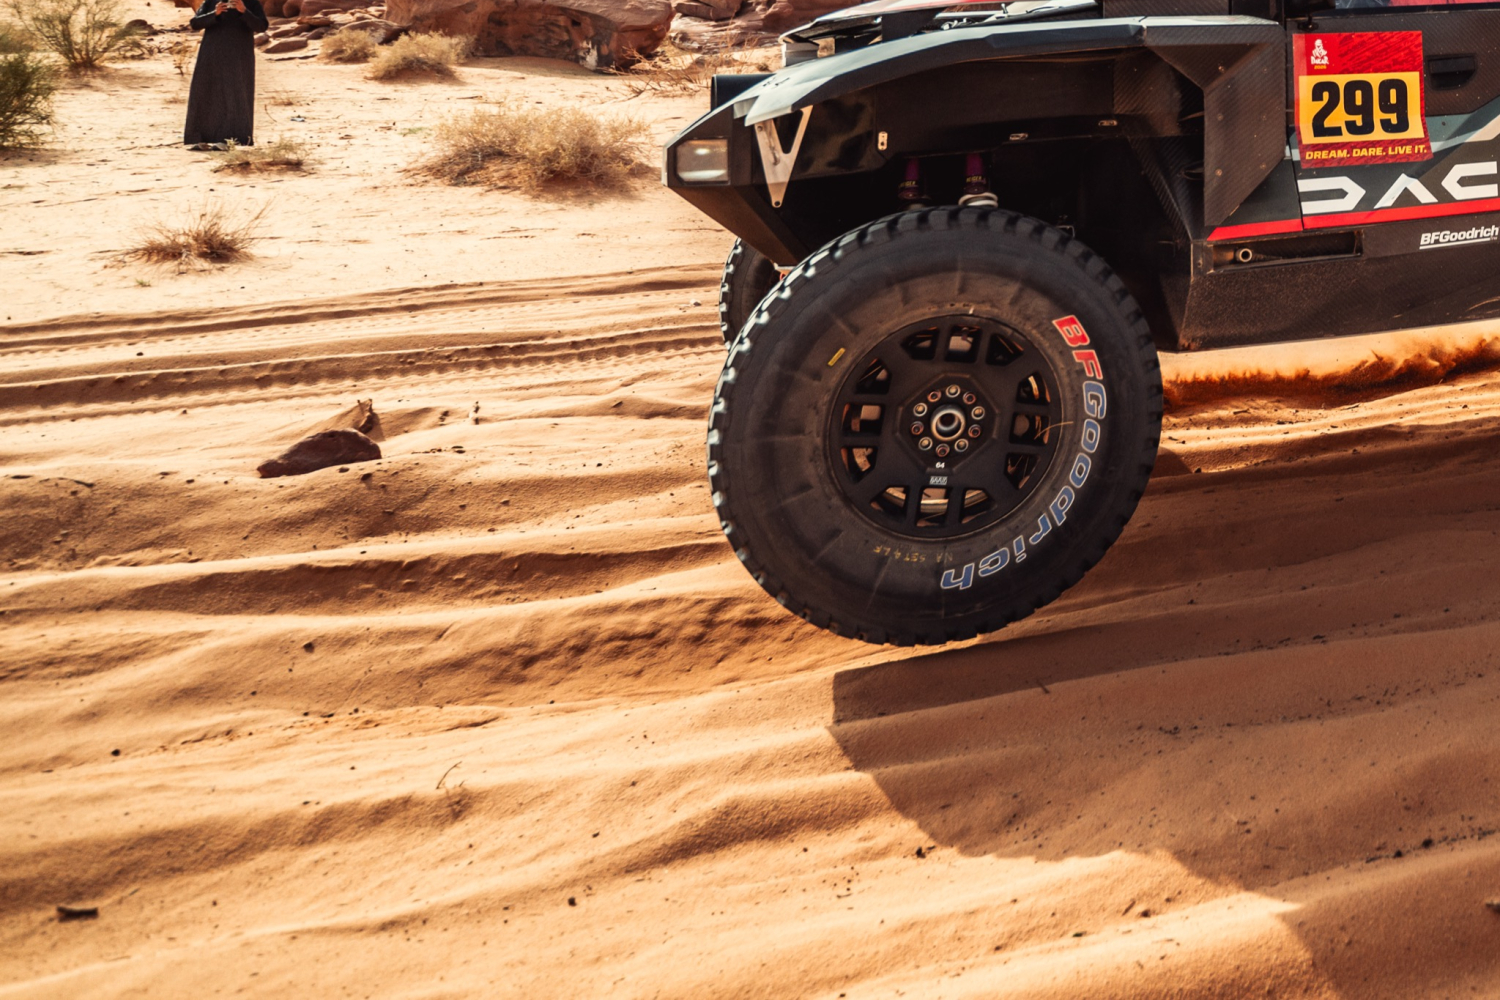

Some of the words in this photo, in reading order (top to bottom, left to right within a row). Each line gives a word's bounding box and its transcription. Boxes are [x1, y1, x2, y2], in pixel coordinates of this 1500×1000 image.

[1311, 78, 1410, 138] 299
[1305, 149, 1350, 160] DREAM.
[1352, 147, 1386, 157] DARE.
[1388, 145, 1412, 155] LIVE
[1414, 144, 1427, 154] IT.
[1420, 224, 1499, 246] BFGoodrich
[940, 314, 1108, 590] BFGoodrich
